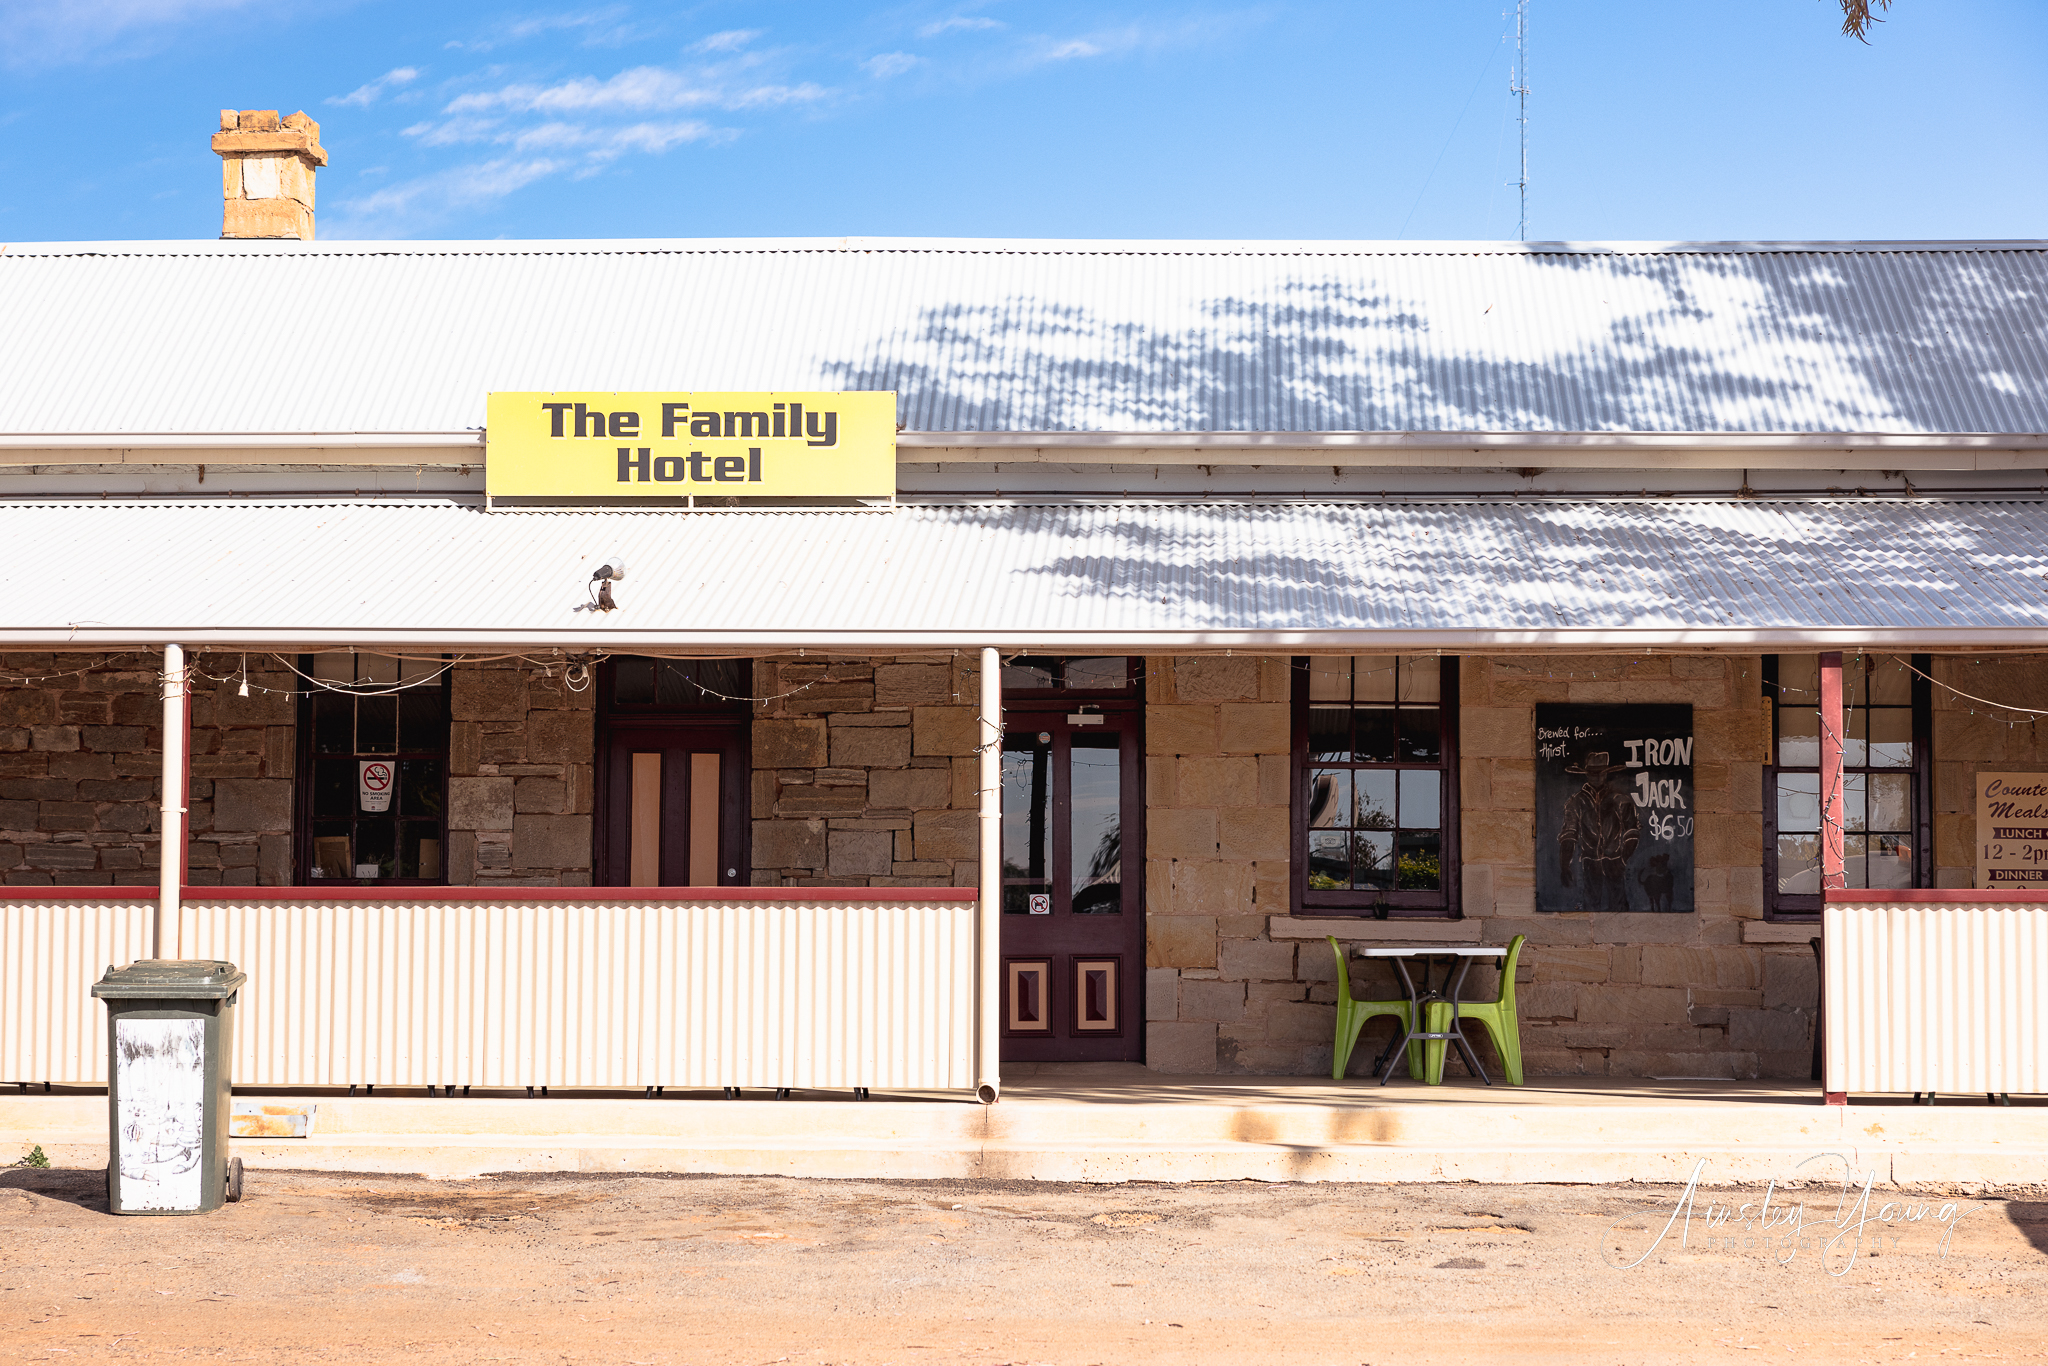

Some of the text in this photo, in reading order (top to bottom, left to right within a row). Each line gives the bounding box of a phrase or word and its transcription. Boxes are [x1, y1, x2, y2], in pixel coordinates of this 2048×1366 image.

[542, 402, 838, 448] The Family
[616, 447, 764, 484] Hotel
[1537, 726, 1570, 740] Brewed
[1623, 736, 1693, 768] IRON
[1630, 771, 1687, 809] JACK
[1984, 779, 2048, 799] Counte
[1988, 801, 2048, 819] Meals
[2000, 829, 2042, 839] LUNCH
[1983, 843, 2003, 860] 12
[2022, 844, 2048, 865] 2p
[1995, 870, 2043, 880] DINNER
